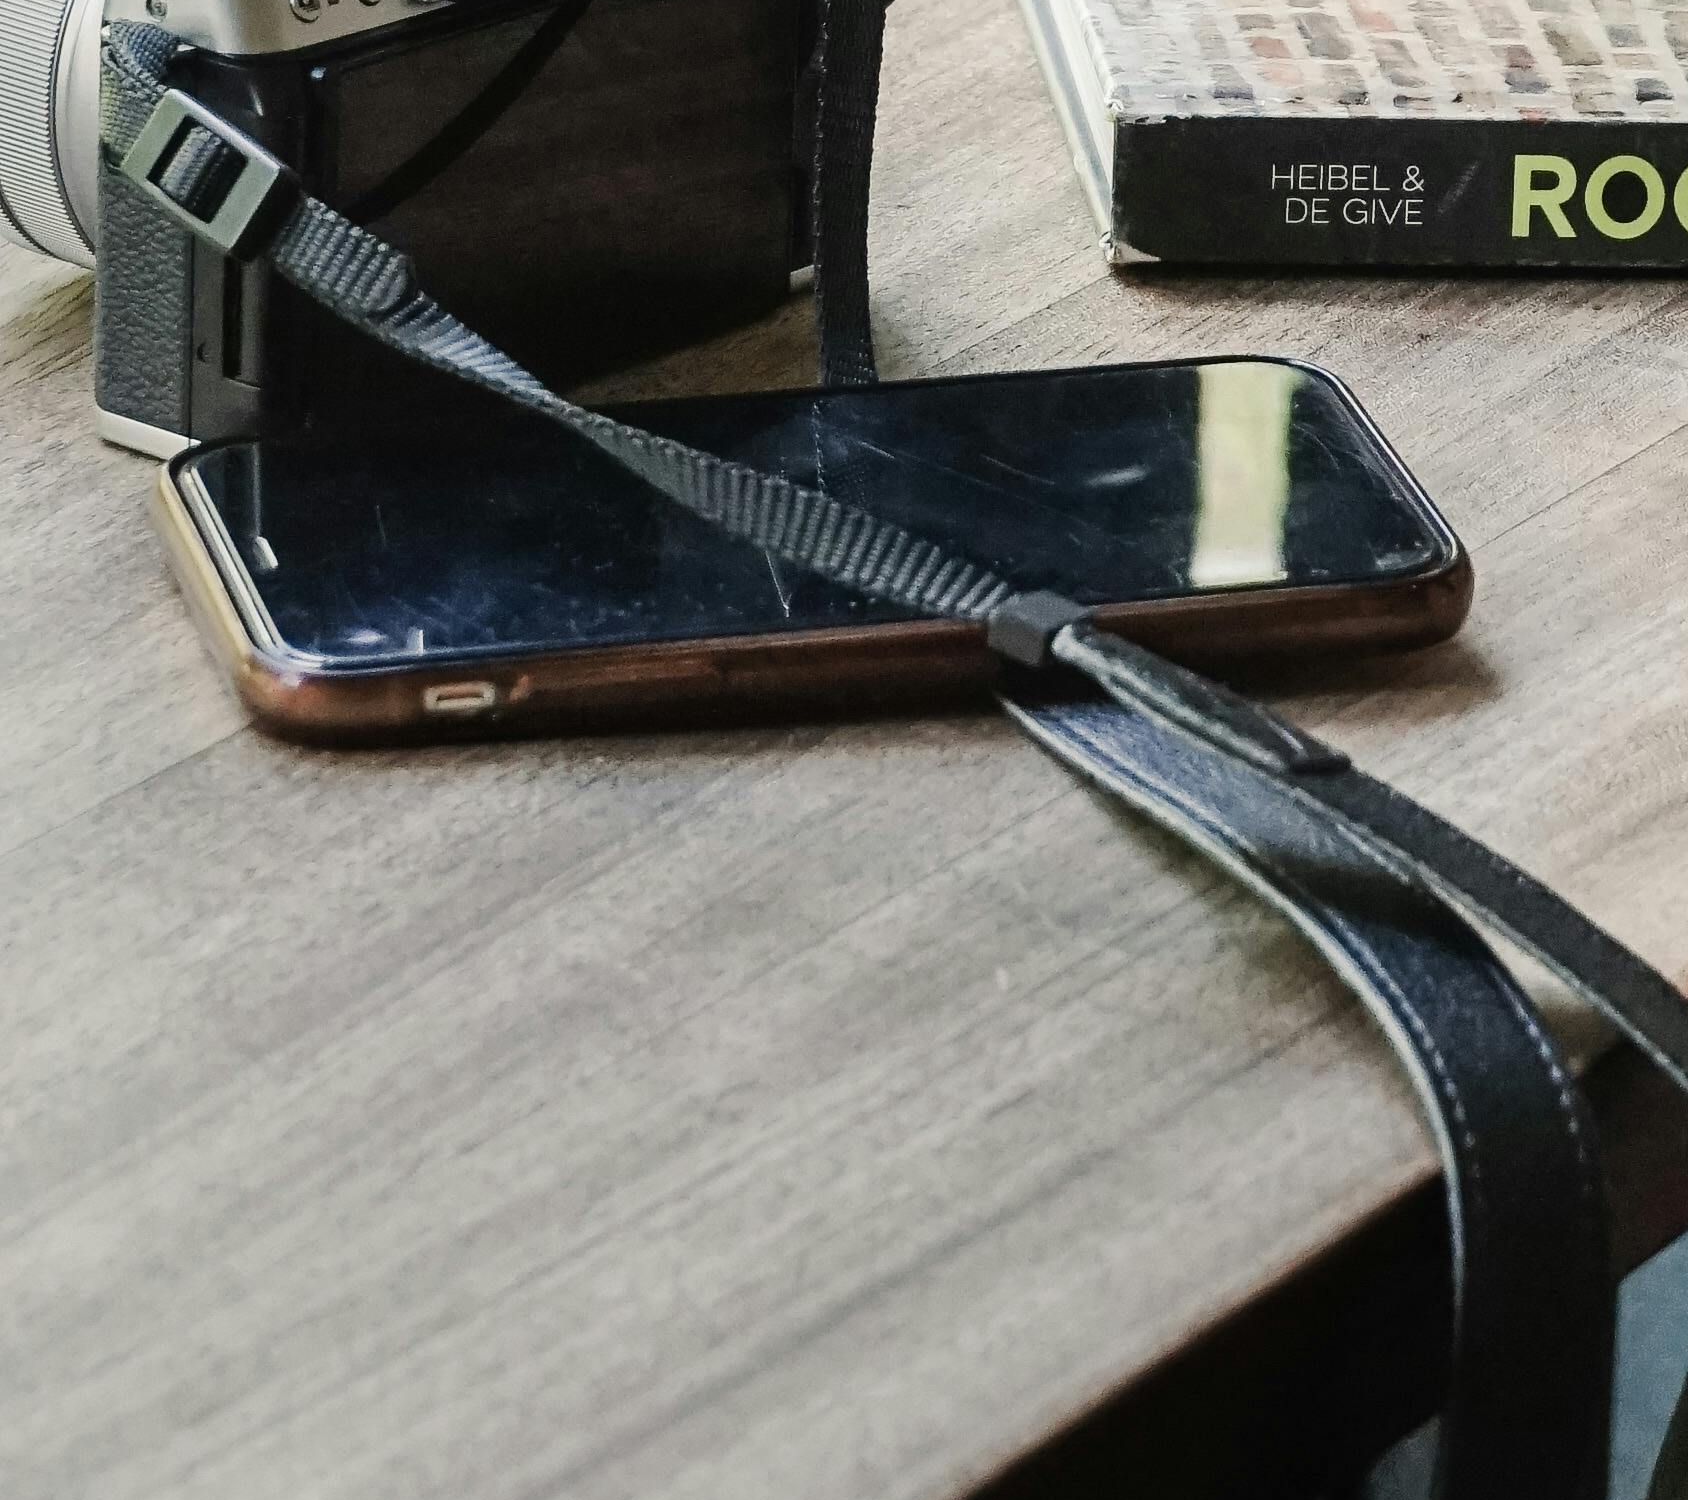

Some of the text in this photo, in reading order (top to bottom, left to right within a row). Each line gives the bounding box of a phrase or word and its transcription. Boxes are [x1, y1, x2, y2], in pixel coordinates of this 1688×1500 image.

[1270, 163, 1426, 192] HEIBEL &
[1285, 197, 1426, 226] DE GIVE
